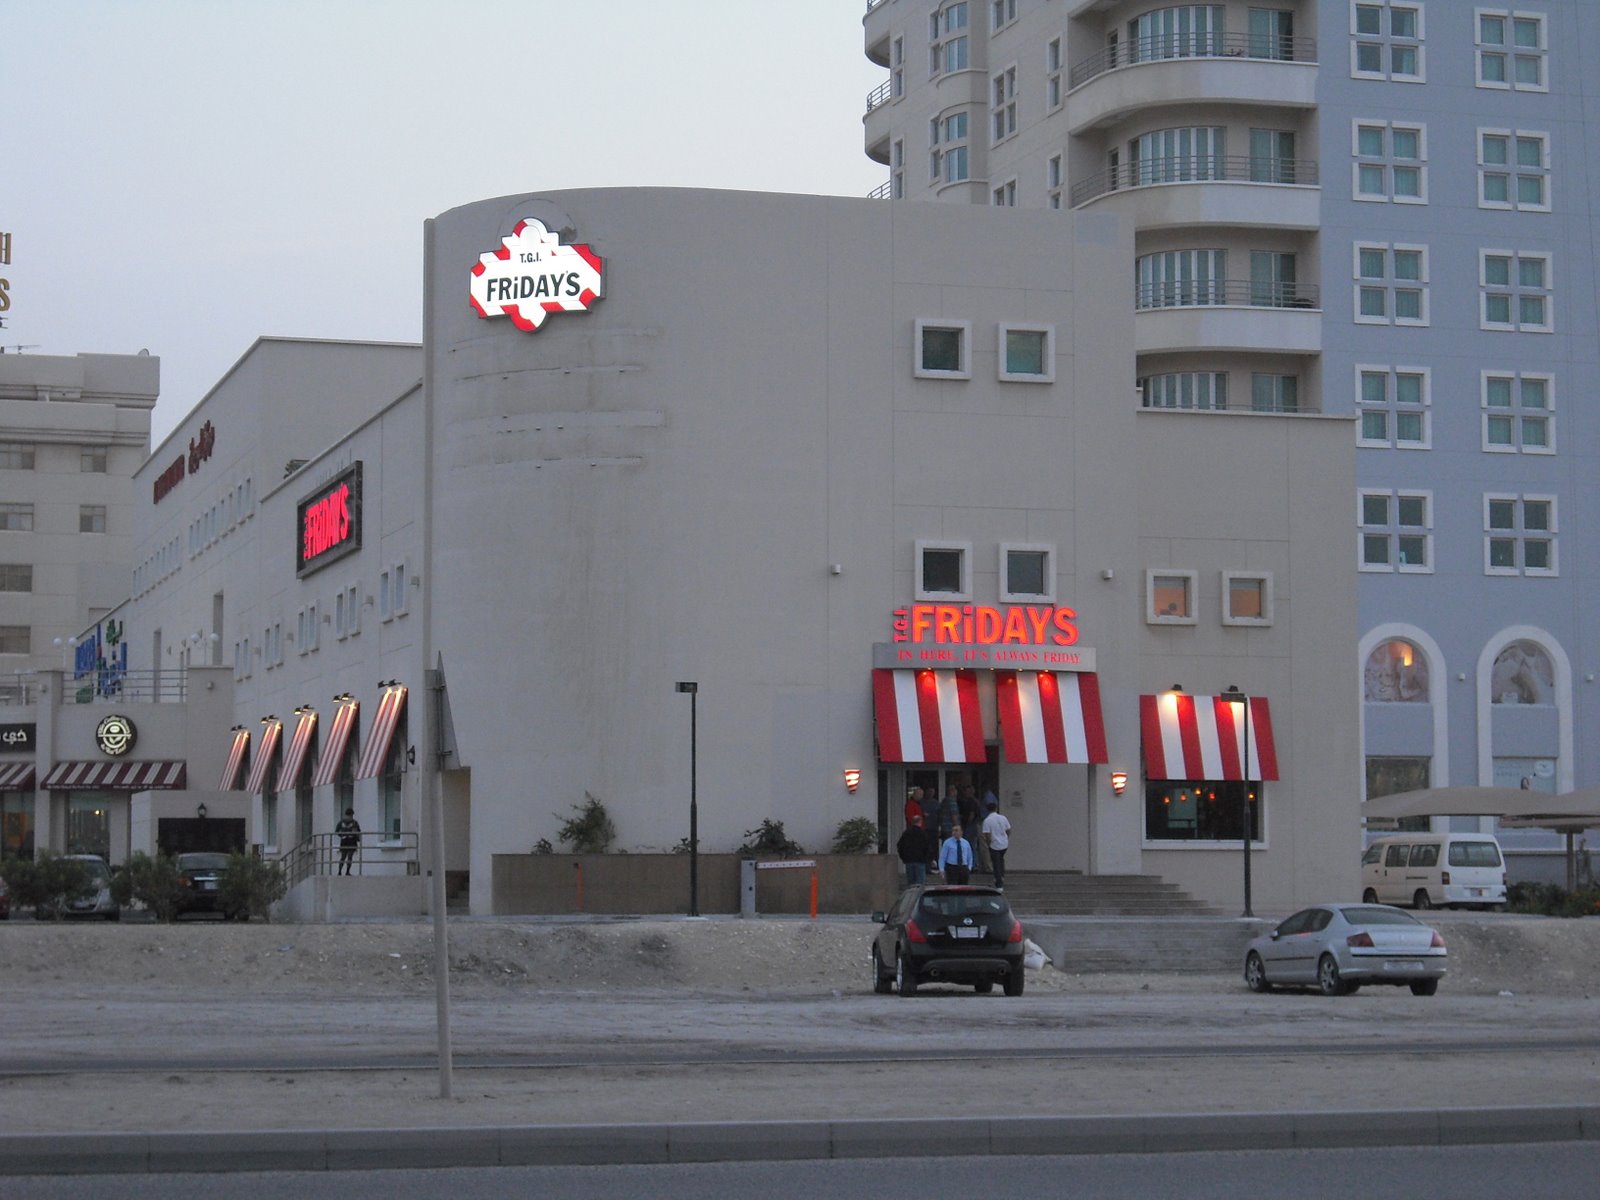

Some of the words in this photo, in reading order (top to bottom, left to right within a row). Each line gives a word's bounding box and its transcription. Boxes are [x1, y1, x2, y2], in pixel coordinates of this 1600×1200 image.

[519, 252, 542, 264] T.G.I.
[897, 649, 913, 661] IN
[994, 650, 1039, 662] ALWAYS
[1043, 651, 1081, 665] FRIDAY
